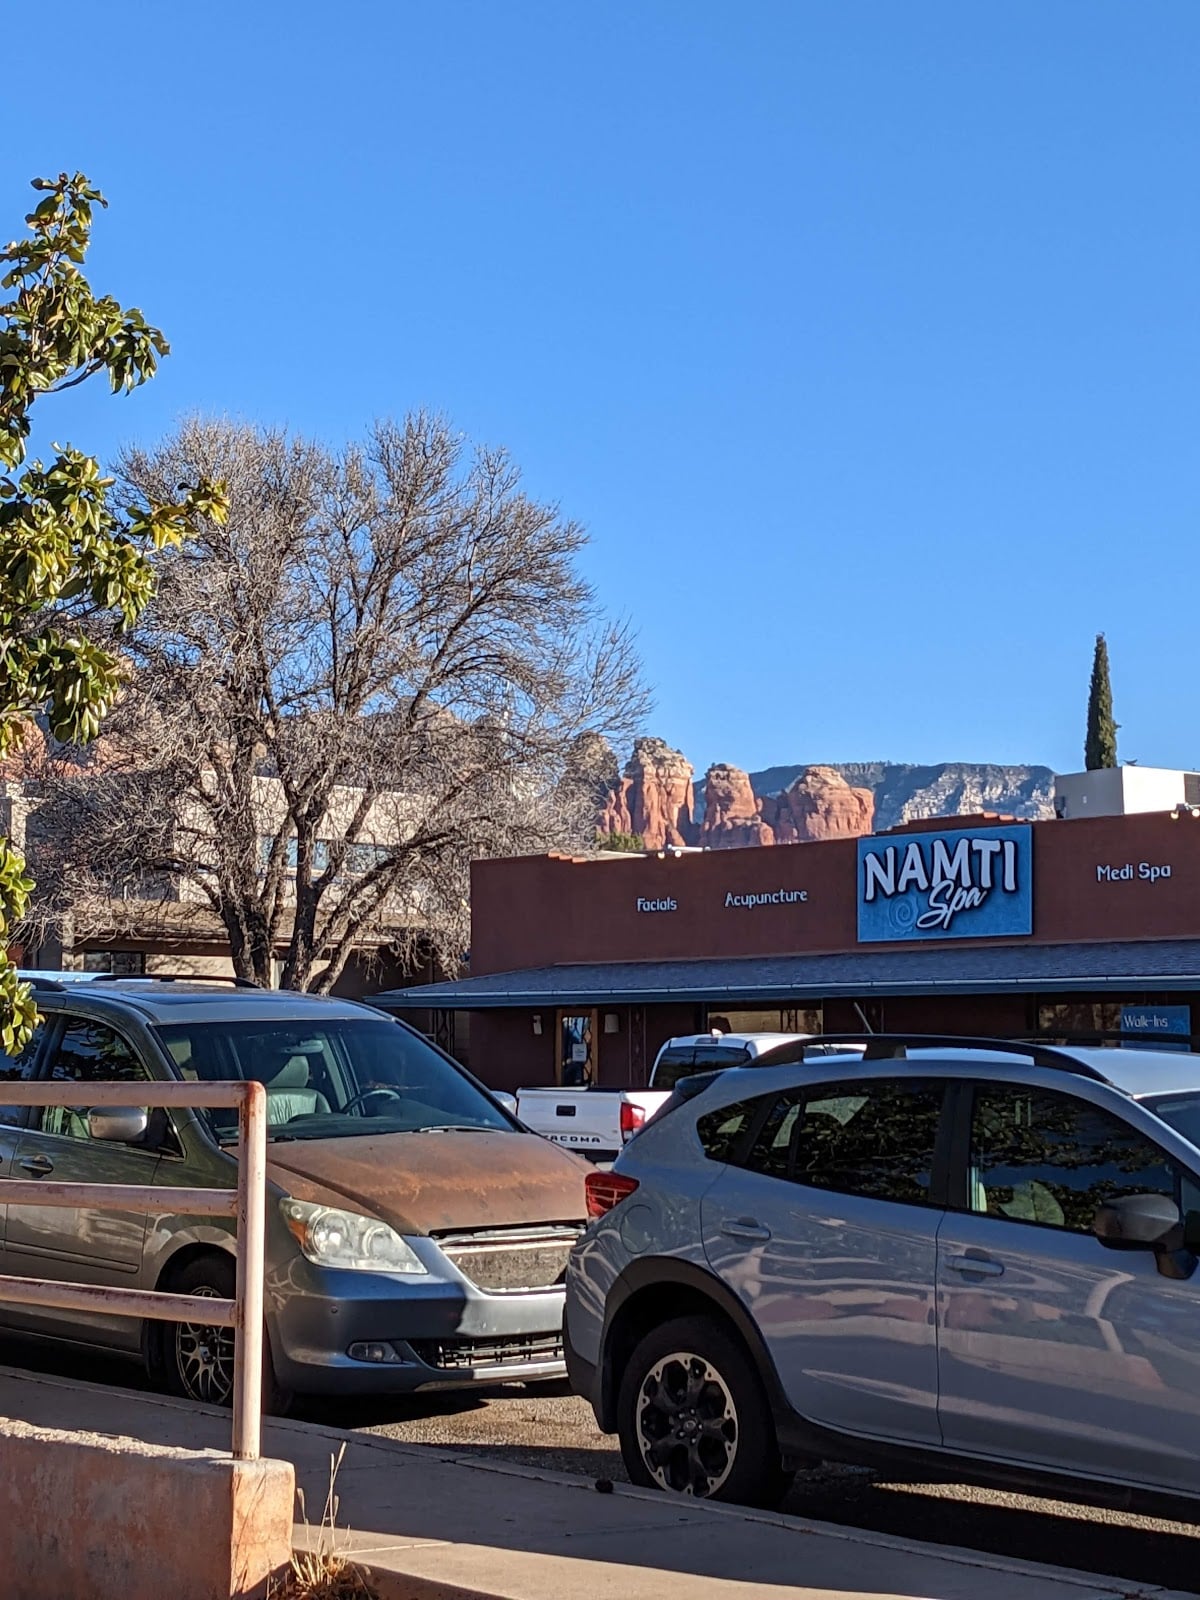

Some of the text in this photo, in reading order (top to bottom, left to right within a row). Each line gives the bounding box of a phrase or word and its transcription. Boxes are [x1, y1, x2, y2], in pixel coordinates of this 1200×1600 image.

[865, 838, 1016, 901] NAMTI
[1096, 862, 1171, 882] Medi Spa
[637, 896, 677, 912] Facials
[724, 889, 808, 909] Acupuncture
[916, 879, 987, 930] Spa
[1123, 1015, 1168, 1028] Walk-Ins
